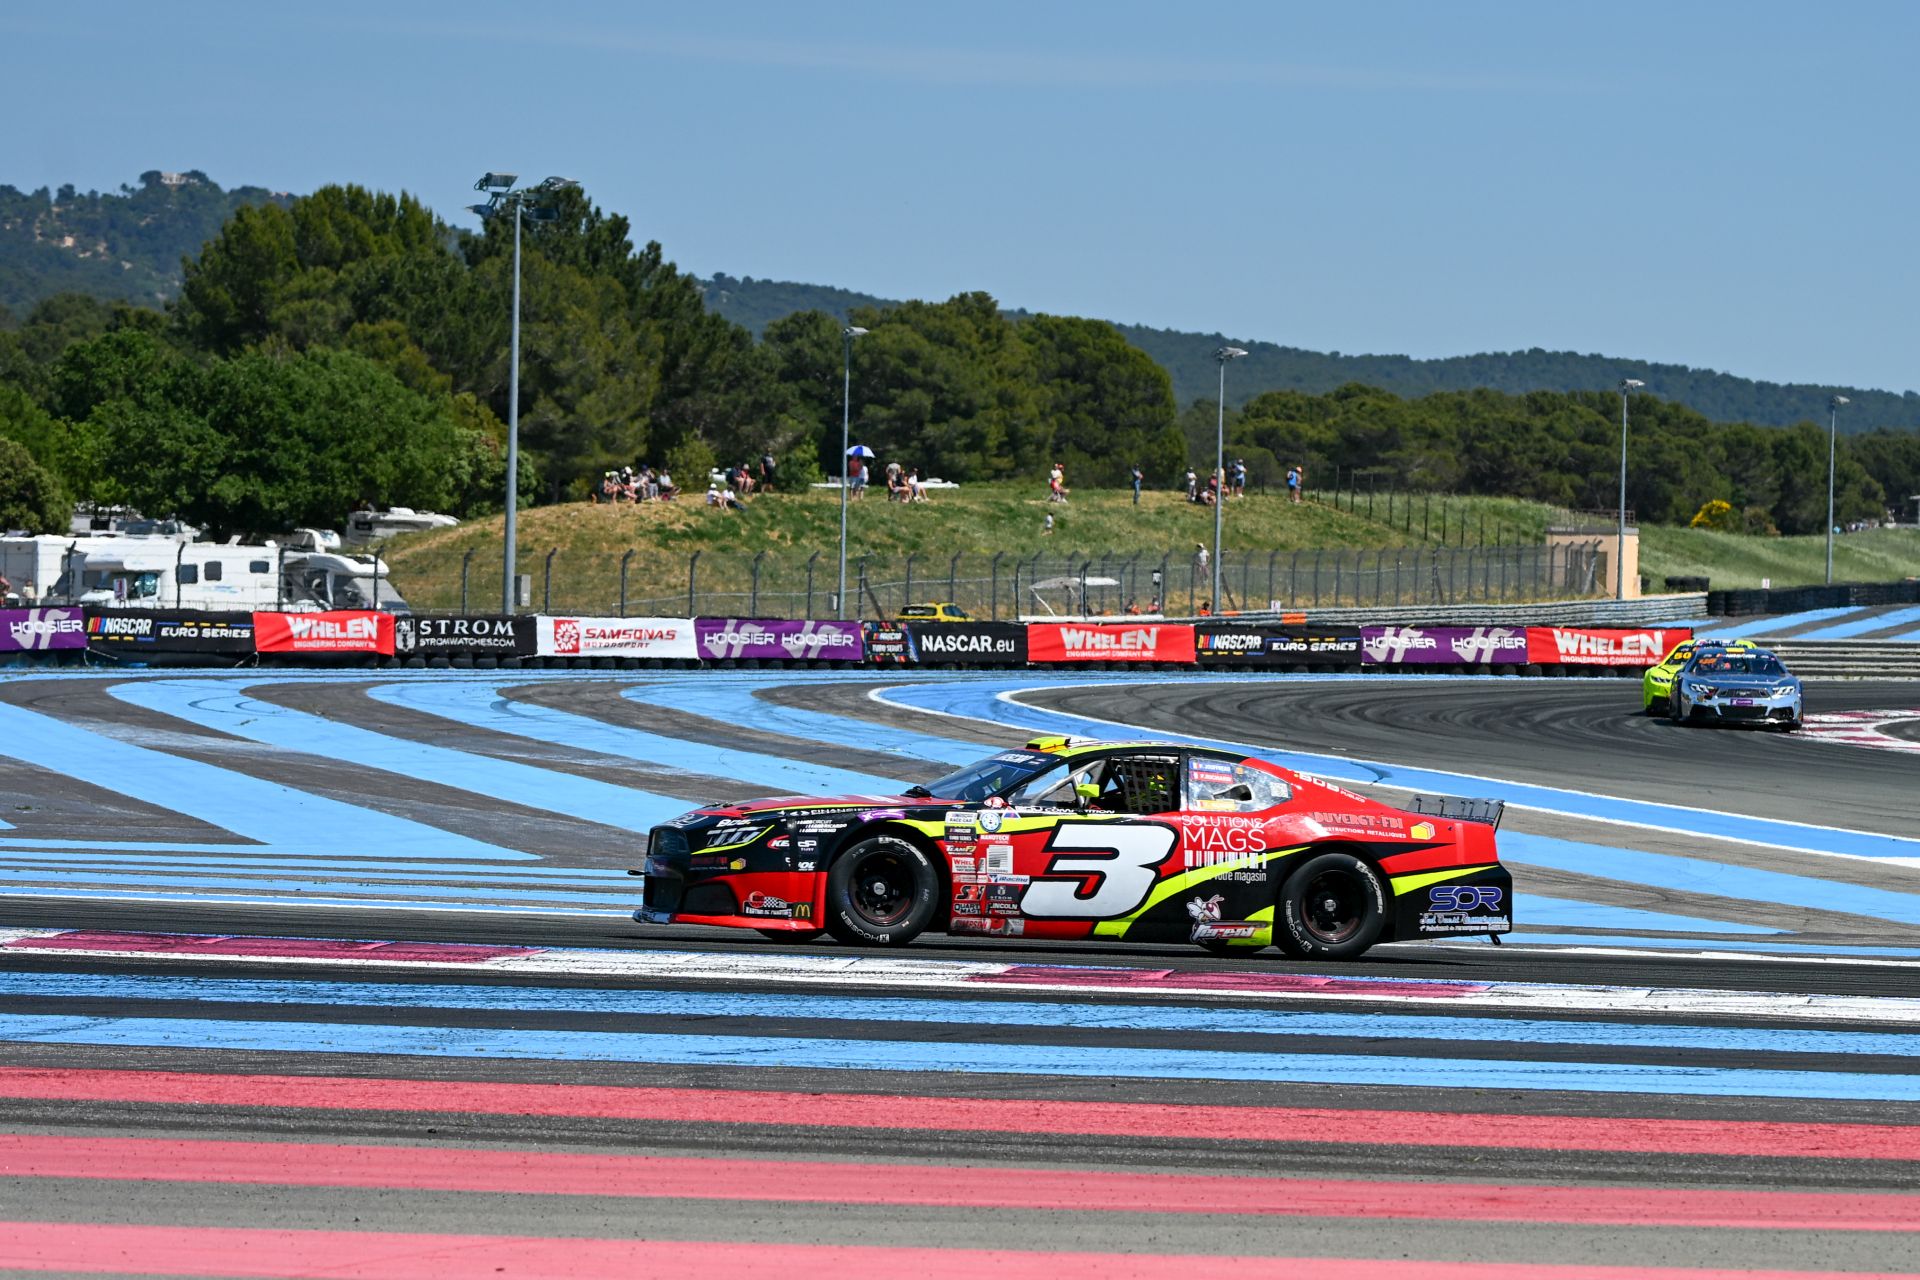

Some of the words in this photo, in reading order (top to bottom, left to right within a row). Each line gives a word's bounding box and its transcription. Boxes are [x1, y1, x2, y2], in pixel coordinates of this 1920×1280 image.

[10, 619, 83, 634] HOOSIER
[104, 617, 153, 635] NASCAR
[161, 626, 199, 638] EURO
[201, 628, 251, 639] SERIES
[285, 615, 379, 639] WHELEN
[419, 619, 516, 637] STROM
[584, 628, 677, 641] SAMSONAS
[419, 637, 516, 648] STROMWATCHES.COM
[584, 641, 650, 649] MOTORSPORT
[703, 632, 776, 646] HOOSIER
[781, 632, 855, 647] HOOSIER
[921, 634, 1015, 653] NASCAR.eu
[1060, 627, 1158, 650] WHELEN
[1213, 634, 1262, 649] NASCAR
[1272, 642, 1308, 651] EURO
[1310, 642, 1357, 652] SERIES
[1363, 636, 1437, 649] HOOSIER
[1451, 636, 1526, 650] HOOSIER
[1552, 629, 1664, 656] WHELEN
[1181, 815, 1265, 829] SOLUTIONS
[1182, 826, 1267, 852] MAGS
[1019, 822, 1177, 918] 3
[1234, 870, 1267, 884] magasin
[1428, 885, 1503, 911] SOR
[840, 910, 880, 943] HOOSIER
[1285, 900, 1304, 944] HOOSIER
